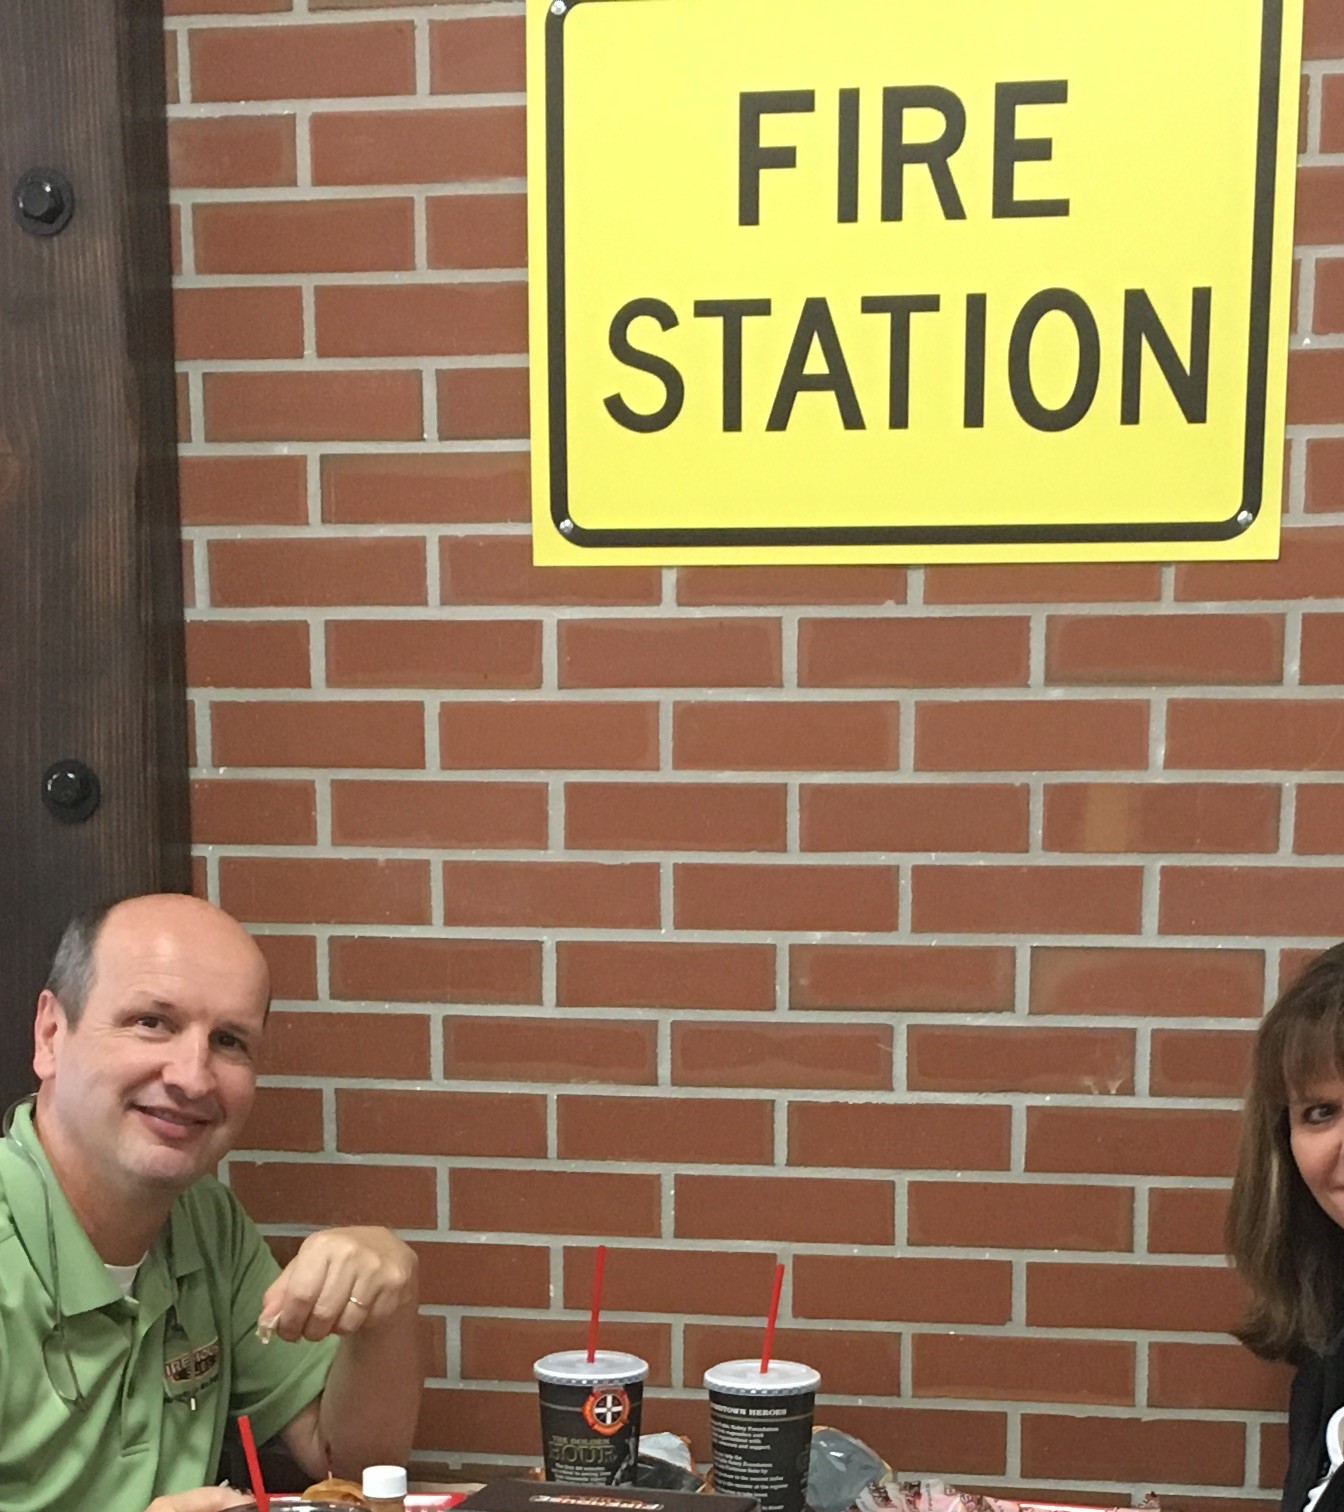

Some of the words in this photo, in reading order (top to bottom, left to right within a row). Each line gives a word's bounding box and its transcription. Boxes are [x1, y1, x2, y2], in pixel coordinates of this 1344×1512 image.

[737, 79, 1072, 227] FIRE
[602, 285, 1213, 433] STATION
[749, 1408, 787, 1416] HEROES
